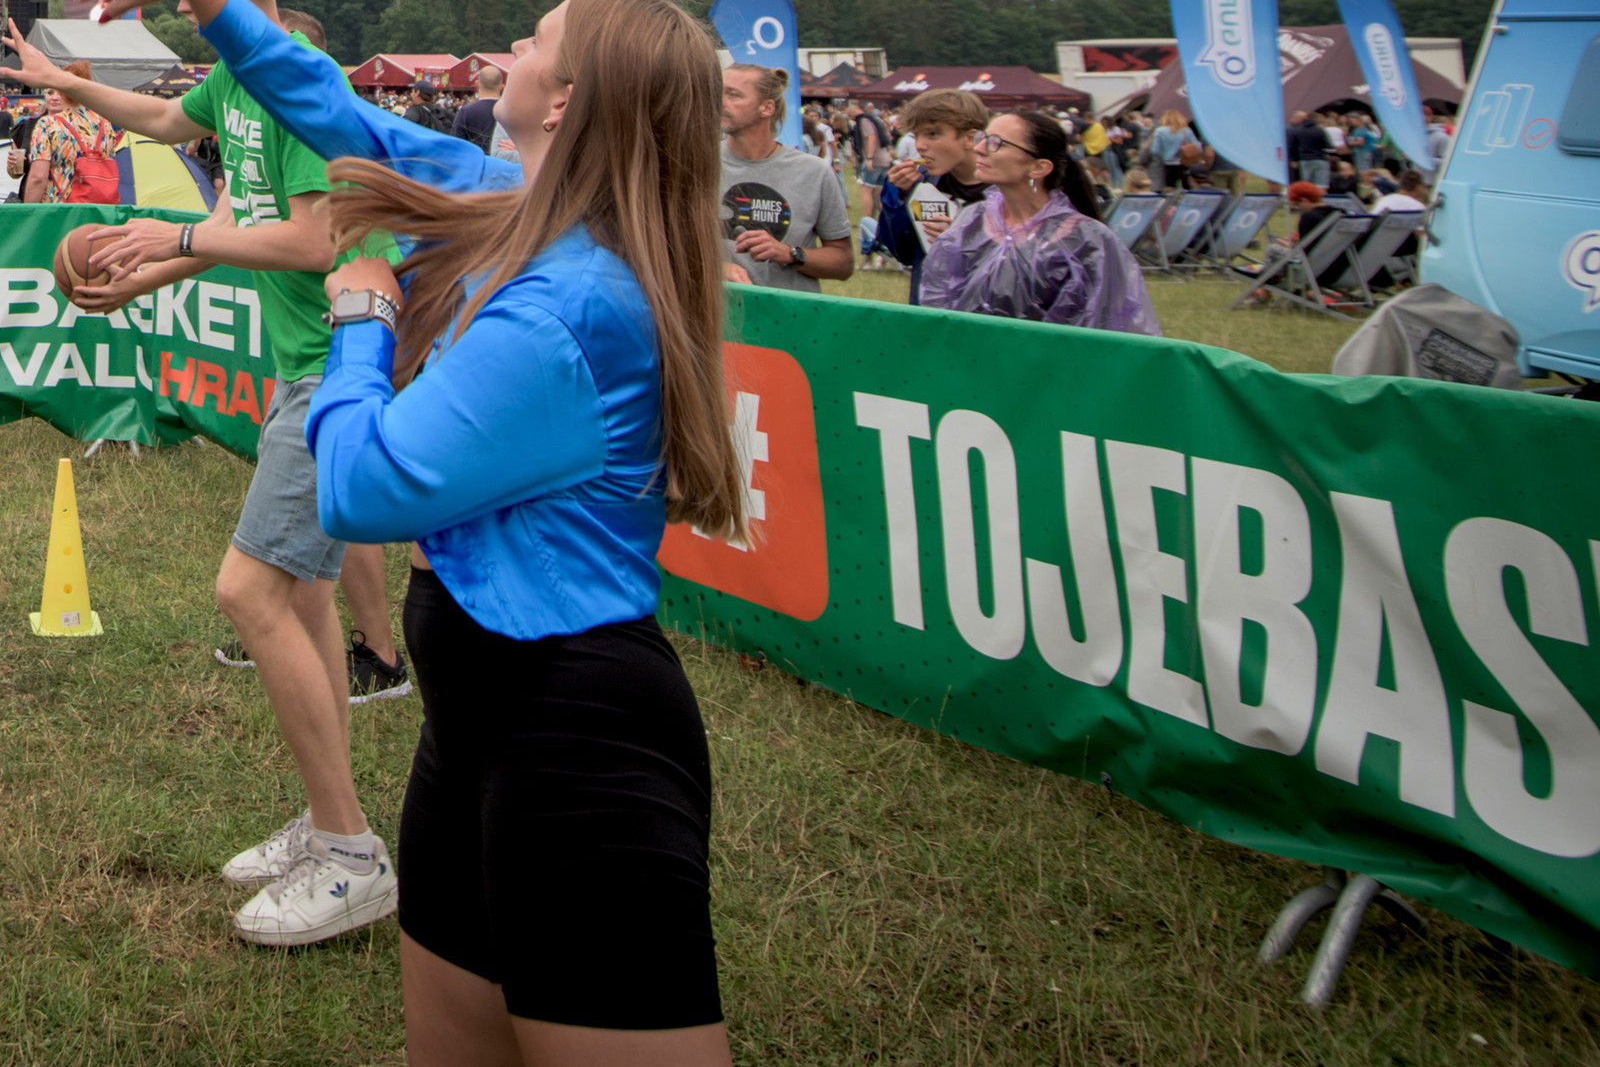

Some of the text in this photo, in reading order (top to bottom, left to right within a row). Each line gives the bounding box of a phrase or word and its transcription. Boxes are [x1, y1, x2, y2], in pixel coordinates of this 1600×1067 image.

[751, 198, 782, 213] JAMES
[752, 209, 781, 224] HUNT
[852, 390, 1600, 858] TOJEBAS
